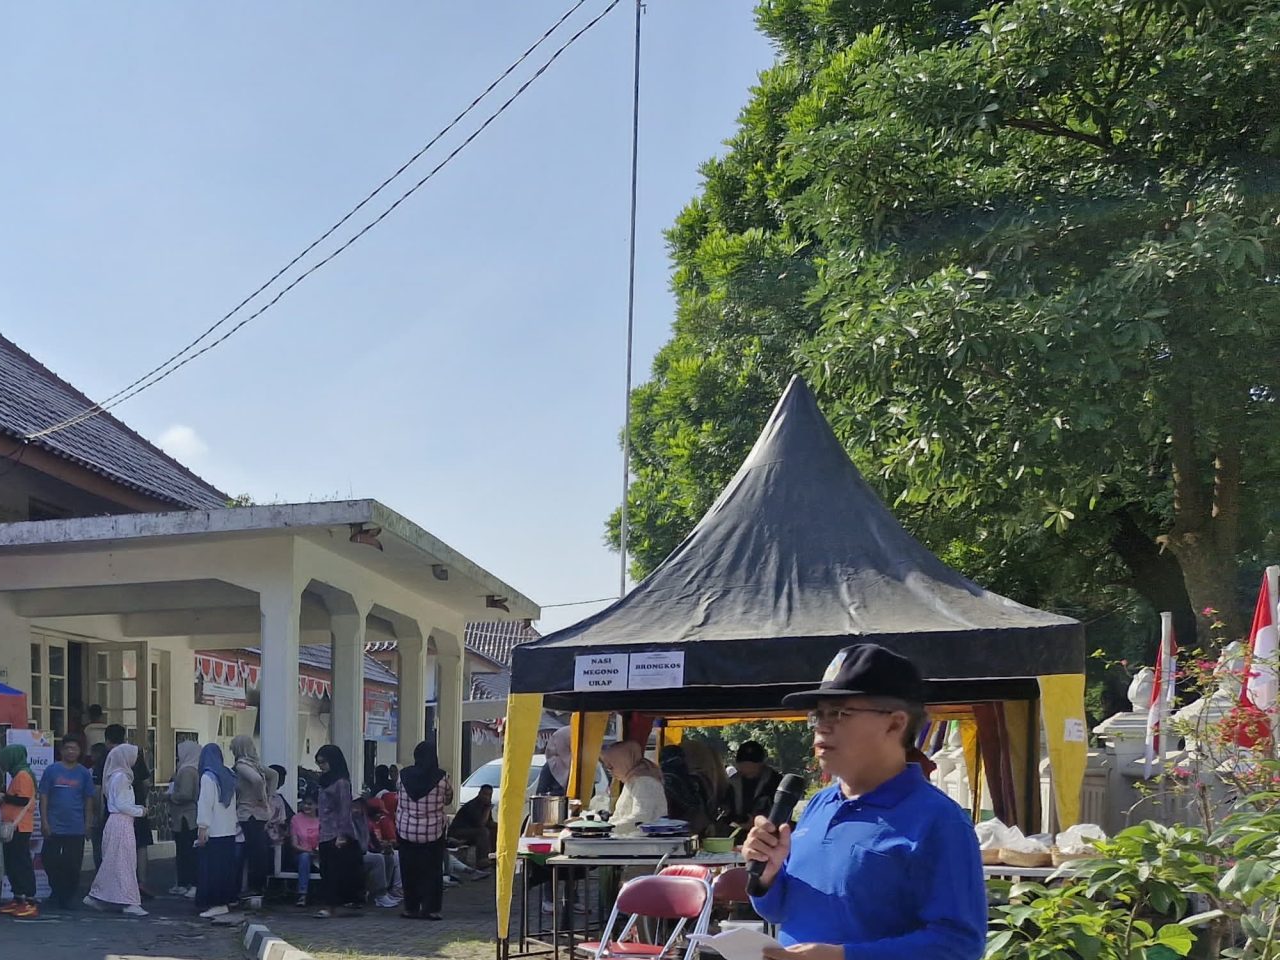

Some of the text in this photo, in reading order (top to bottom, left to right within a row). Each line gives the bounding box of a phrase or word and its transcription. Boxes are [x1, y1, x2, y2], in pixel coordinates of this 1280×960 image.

[591, 657, 612, 665] NASI
[635, 662, 682, 670] BRONGKOS
[583, 668, 619, 676] MEGONO
[588, 679, 613, 687] URAP
